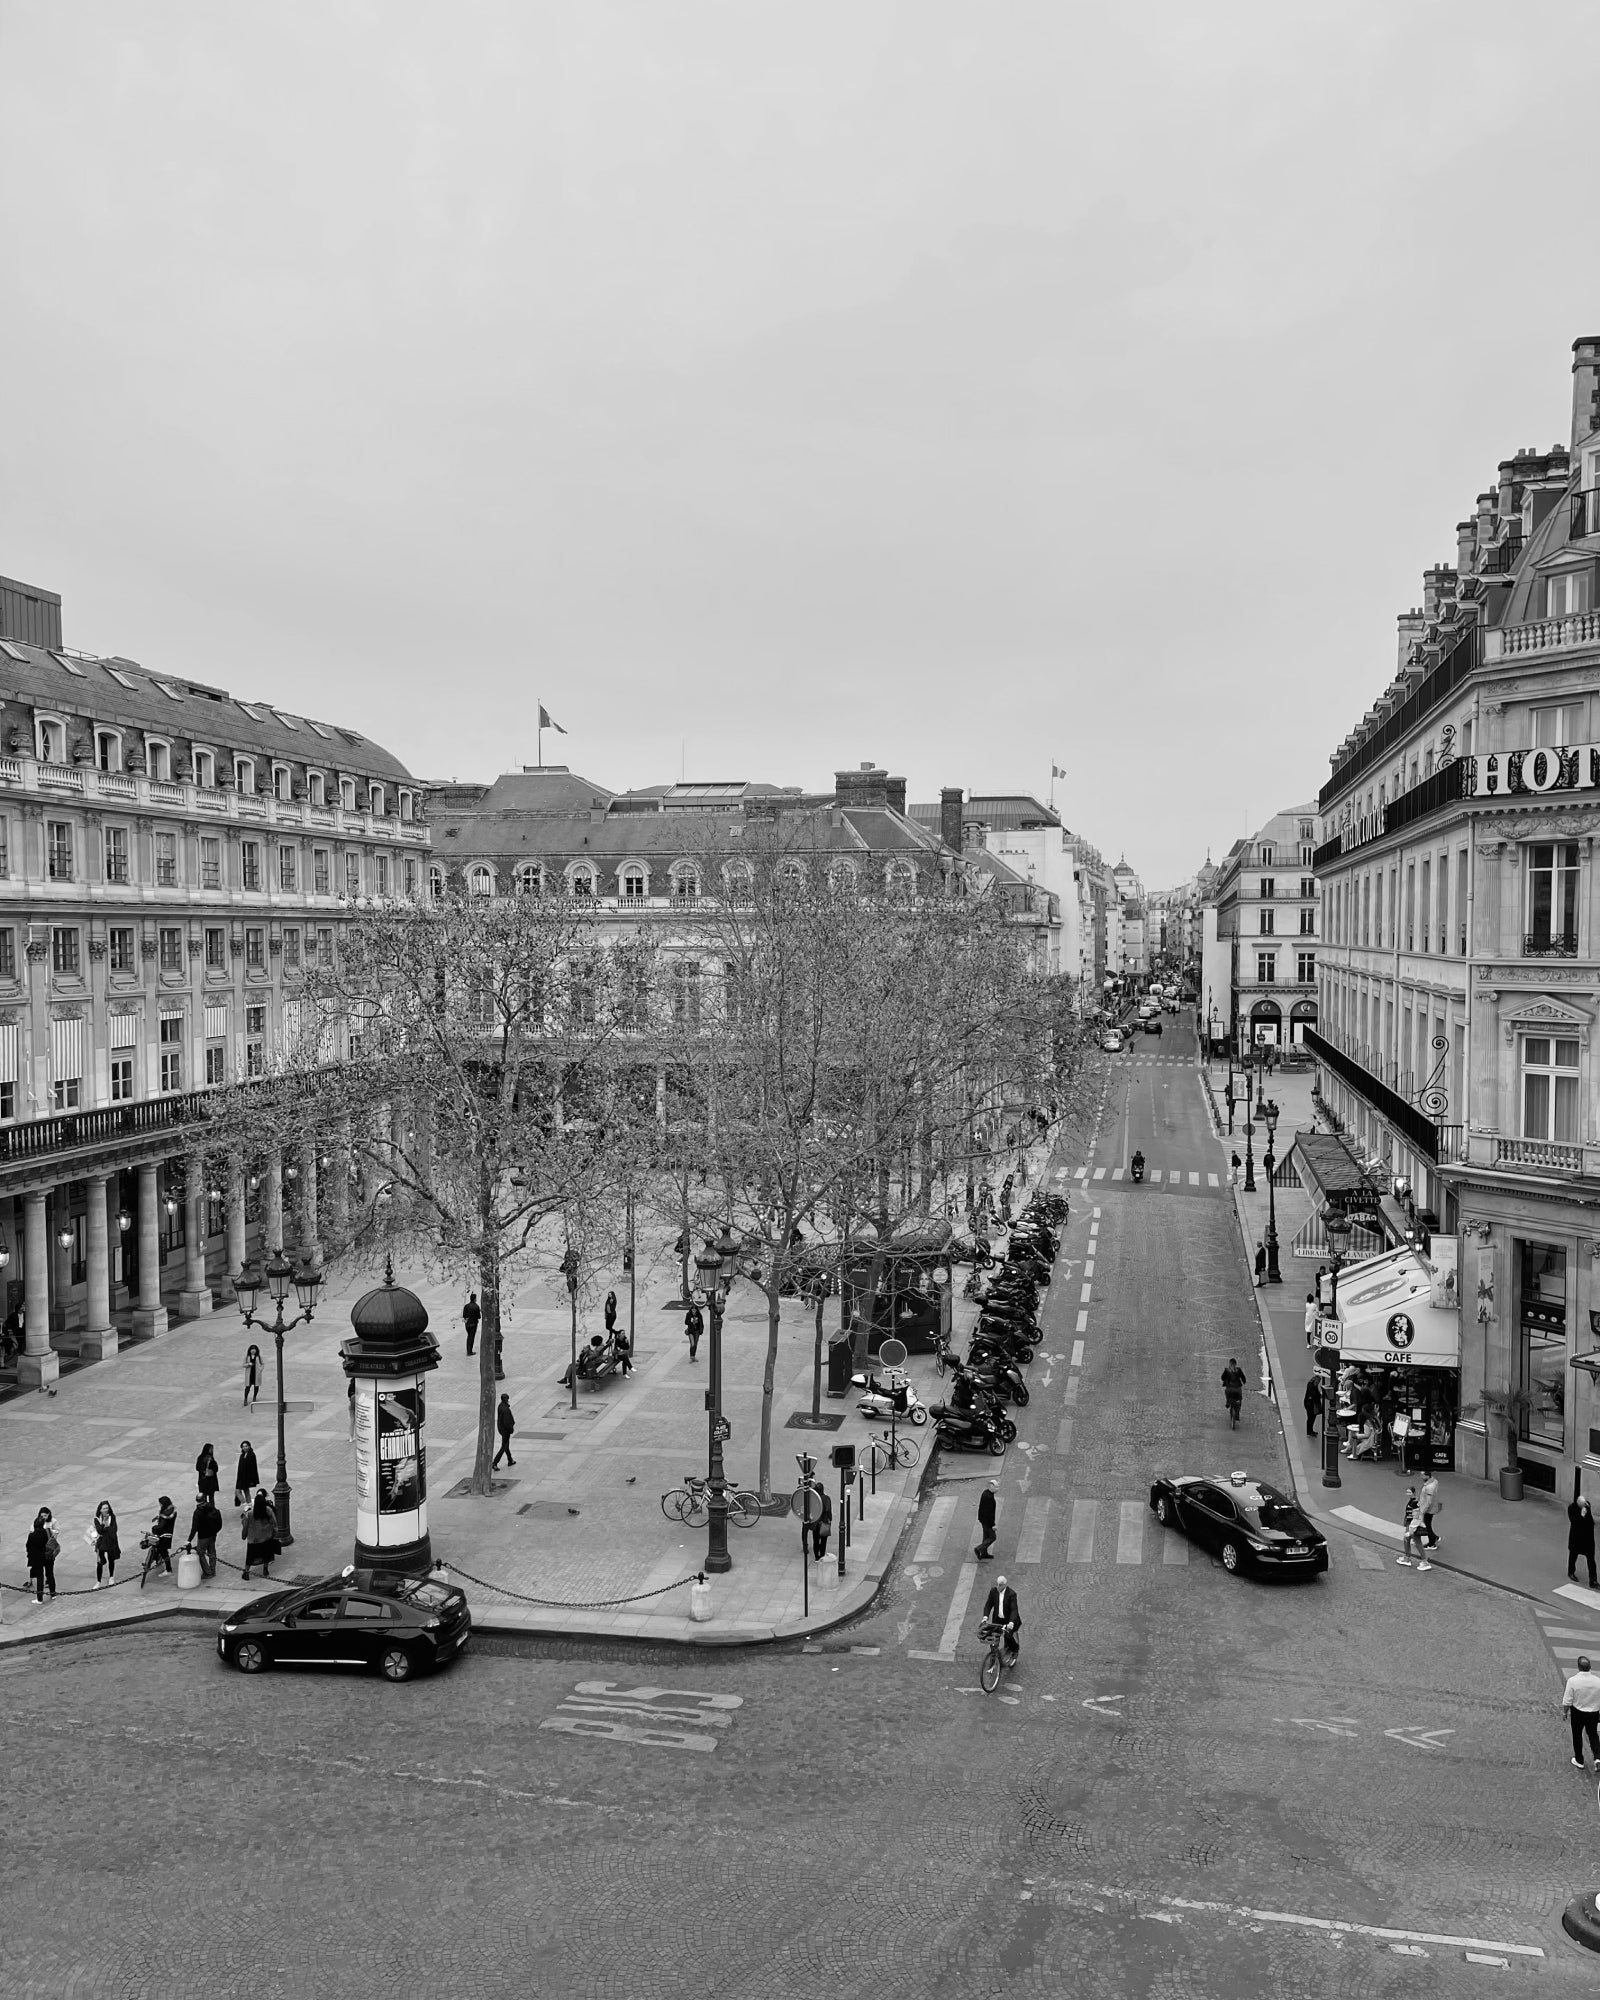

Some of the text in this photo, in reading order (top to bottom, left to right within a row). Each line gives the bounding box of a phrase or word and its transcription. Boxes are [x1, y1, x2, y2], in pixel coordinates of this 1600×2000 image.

[1473, 743, 1600, 796] HOT
[1344, 1196, 1379, 1204] CIVETTE
[1298, 1249, 1330, 1257] LIBRAIRI
[1327, 1333, 1336, 1341] 30
[1384, 1352, 1412, 1363] CAFE
[381, 1428, 415, 1437] POMMET
